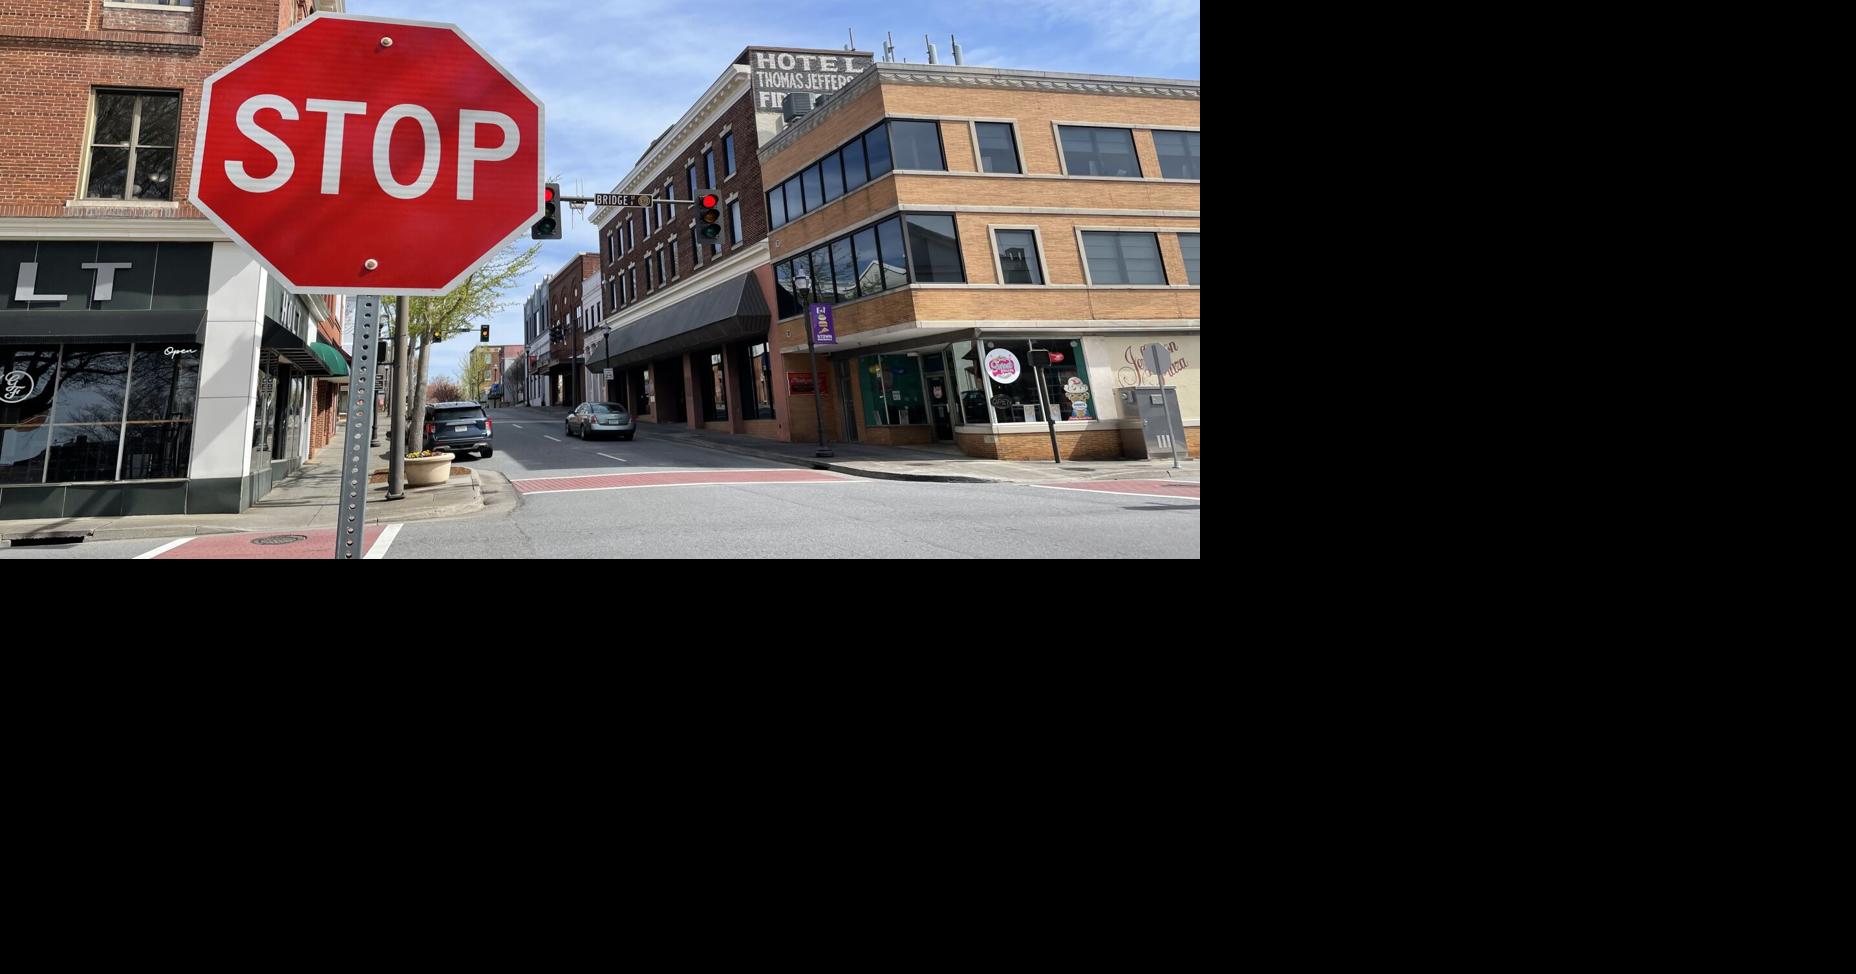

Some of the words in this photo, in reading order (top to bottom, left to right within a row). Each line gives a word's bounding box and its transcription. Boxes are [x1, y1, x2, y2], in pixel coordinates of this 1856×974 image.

[756, 52, 864, 73] HOTEL
[757, 71, 804, 89] THOMAS
[223, 94, 521, 201] STOP
[596, 194, 628, 205] BRIDGE
[14, 262, 132, 302] LT
[163, 346, 198, 360] Open
